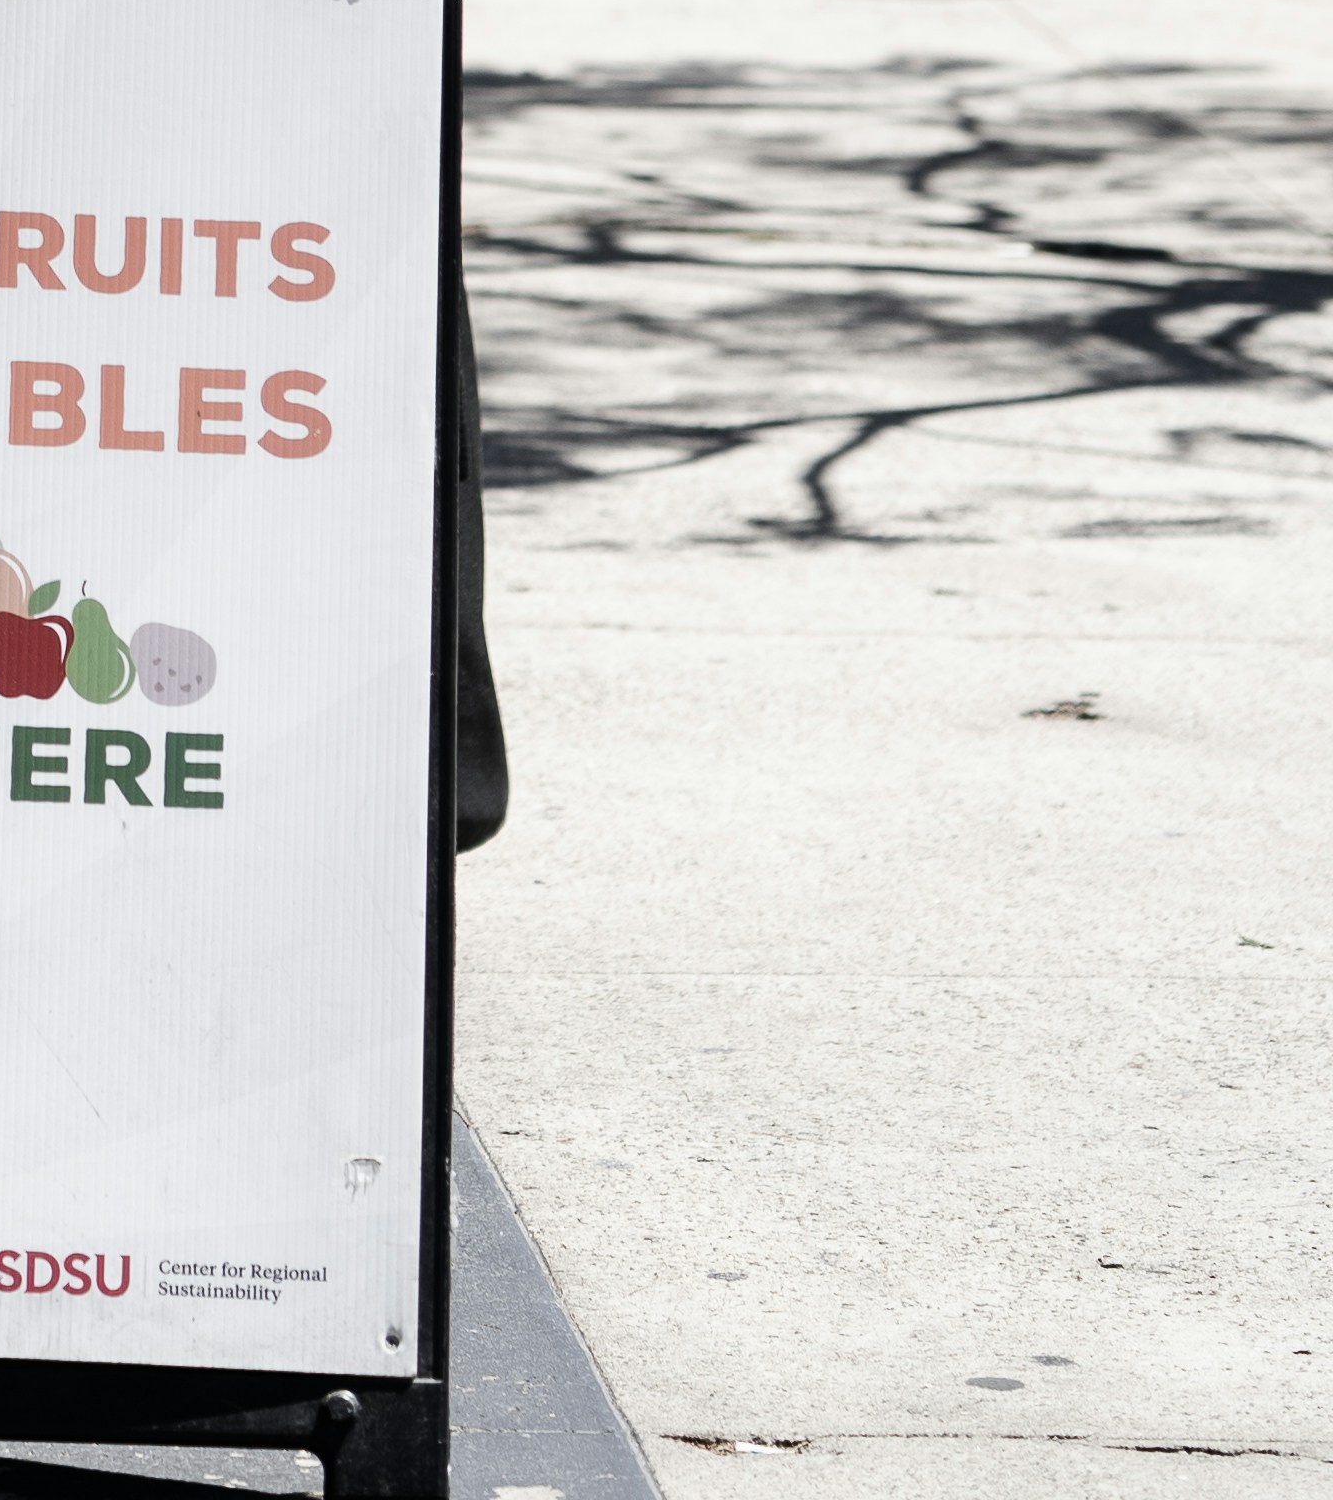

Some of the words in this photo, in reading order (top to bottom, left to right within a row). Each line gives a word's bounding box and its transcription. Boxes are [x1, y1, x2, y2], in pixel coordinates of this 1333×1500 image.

[159, 1260, 216, 1276] Center
[222, 1262, 246, 1278] for
[251, 1264, 326, 1283] Regional
[158, 1279, 283, 1304] Sustainability
